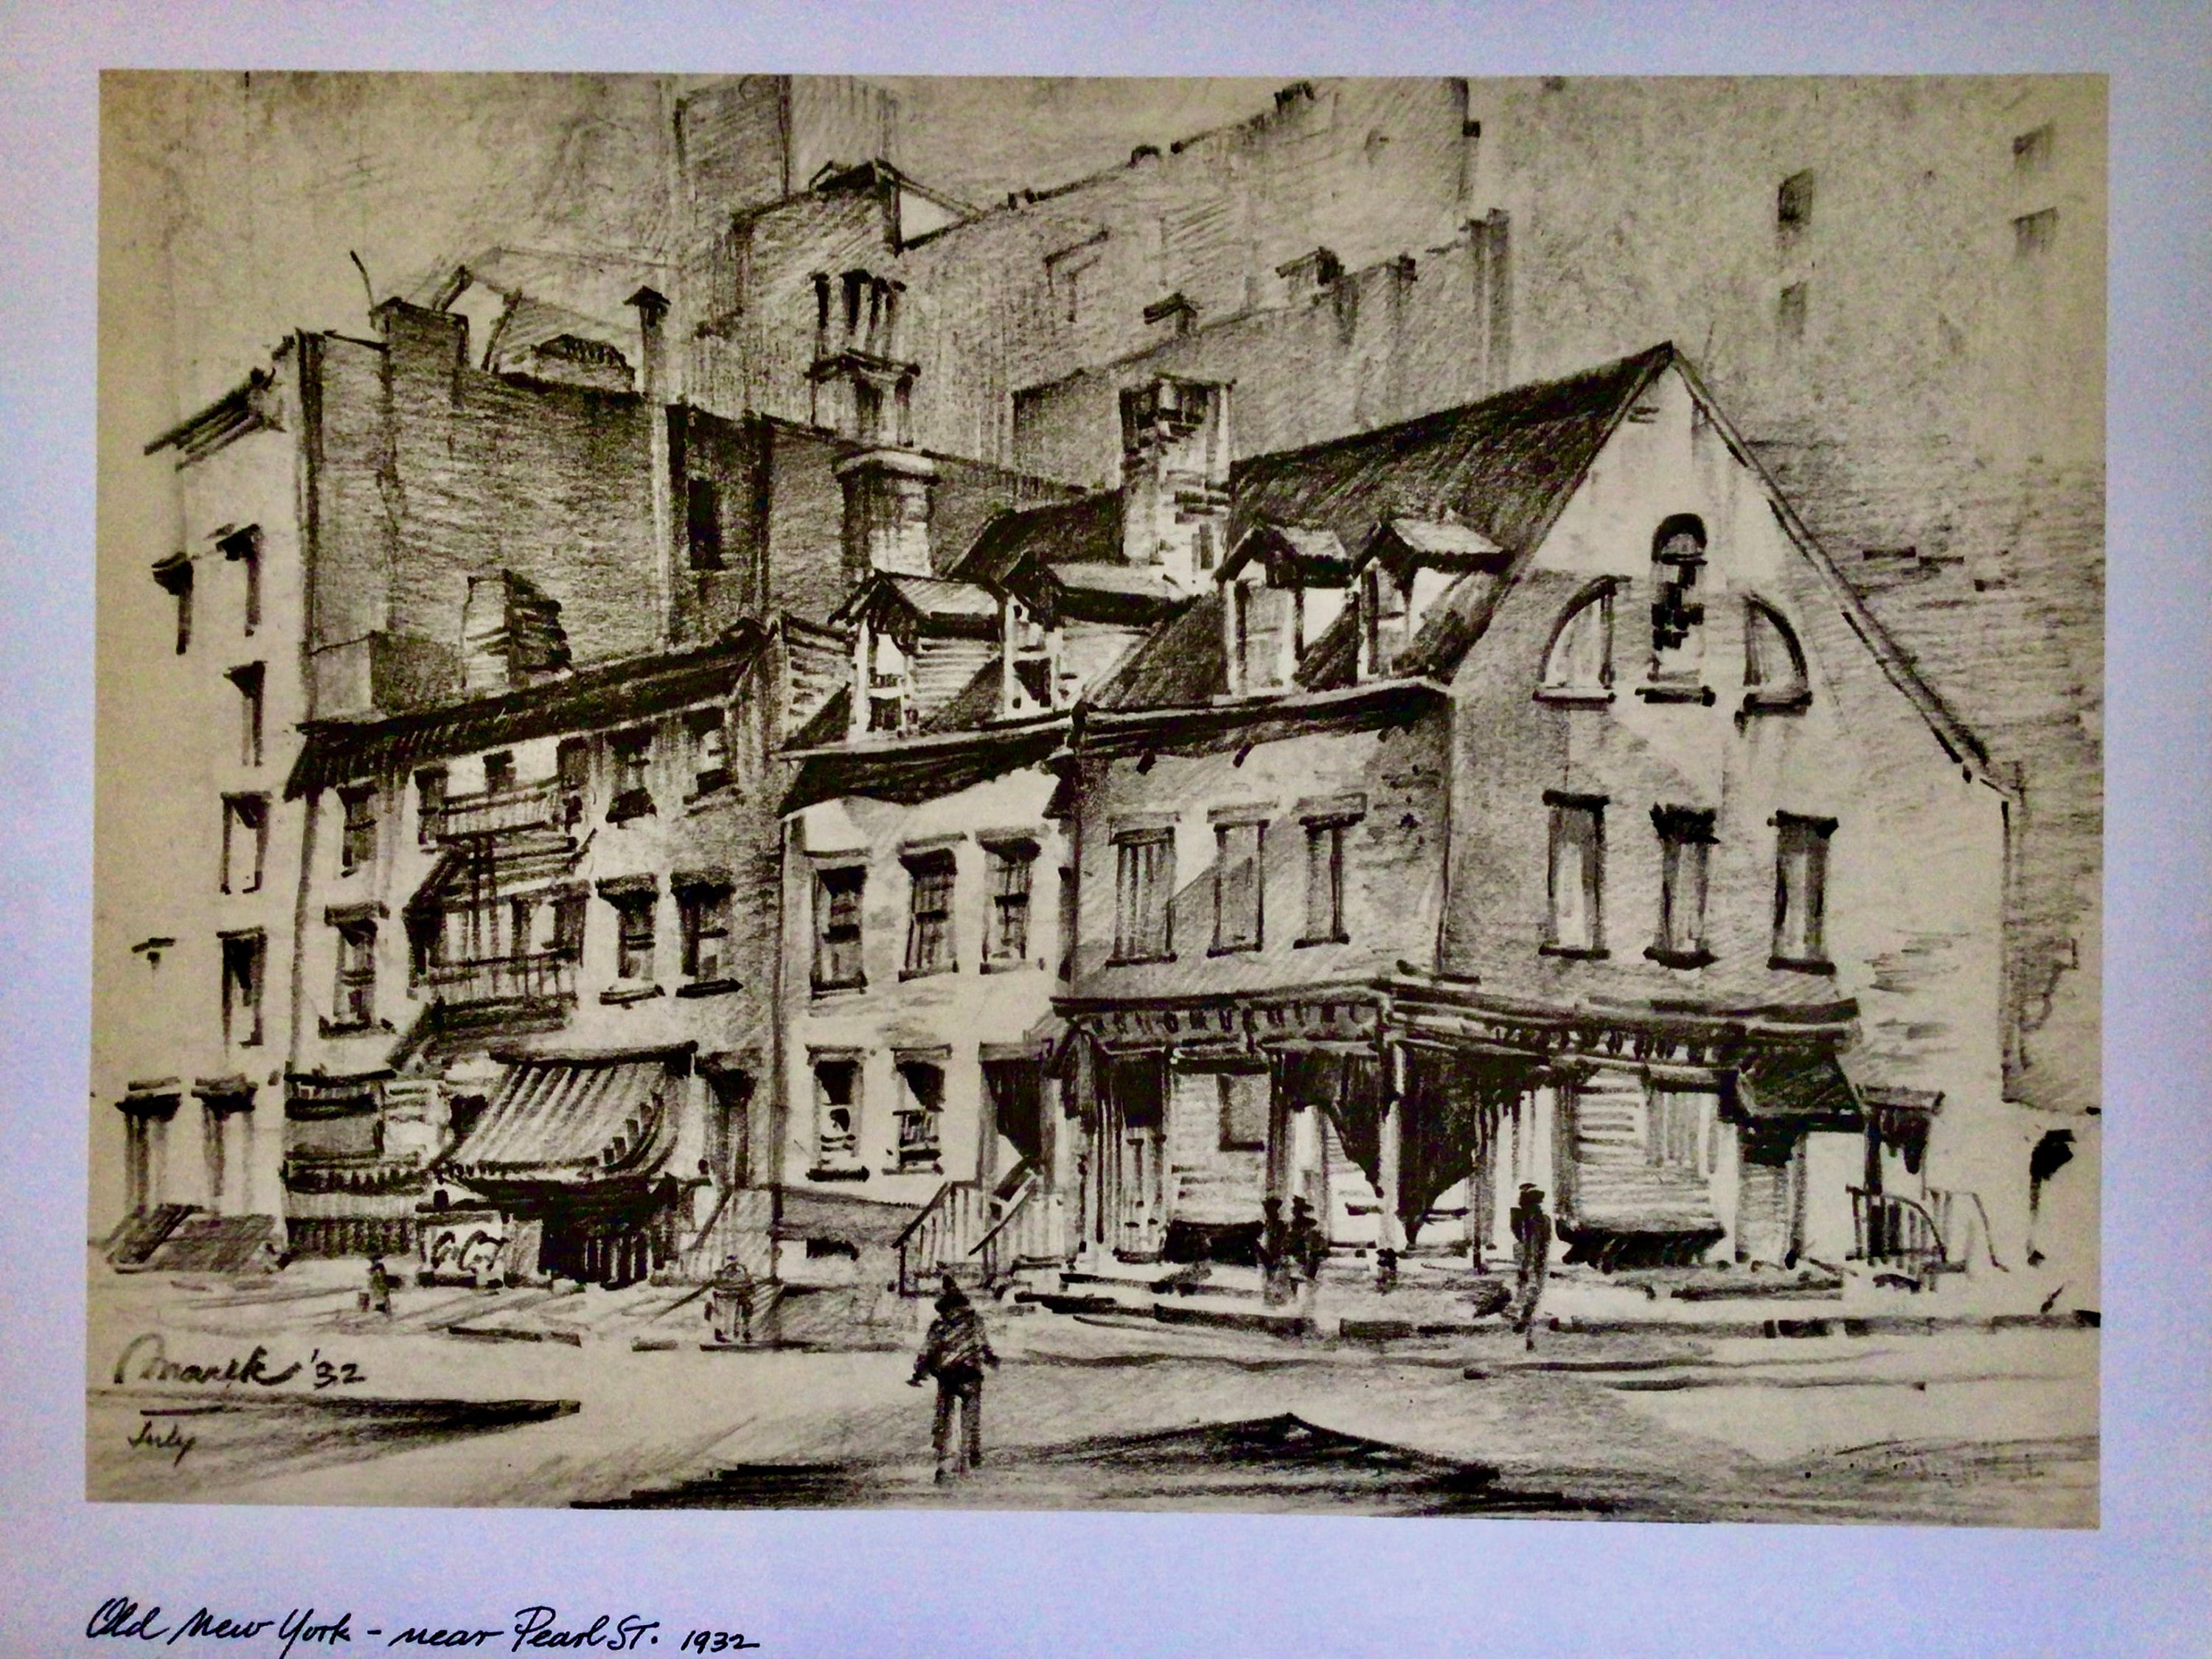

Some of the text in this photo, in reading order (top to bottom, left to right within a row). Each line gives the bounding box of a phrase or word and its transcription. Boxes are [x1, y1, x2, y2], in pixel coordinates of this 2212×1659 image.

[127, 1420, 197, 1467] July
[85, 1596, 170, 1641] Old
[166, 1607, 276, 1646] New
[278, 1607, 352, 1659] York
[387, 1627, 505, 1647] near
[511, 1605, 611, 1653] Pearl
[680, 1630, 761, 1655] 1932
